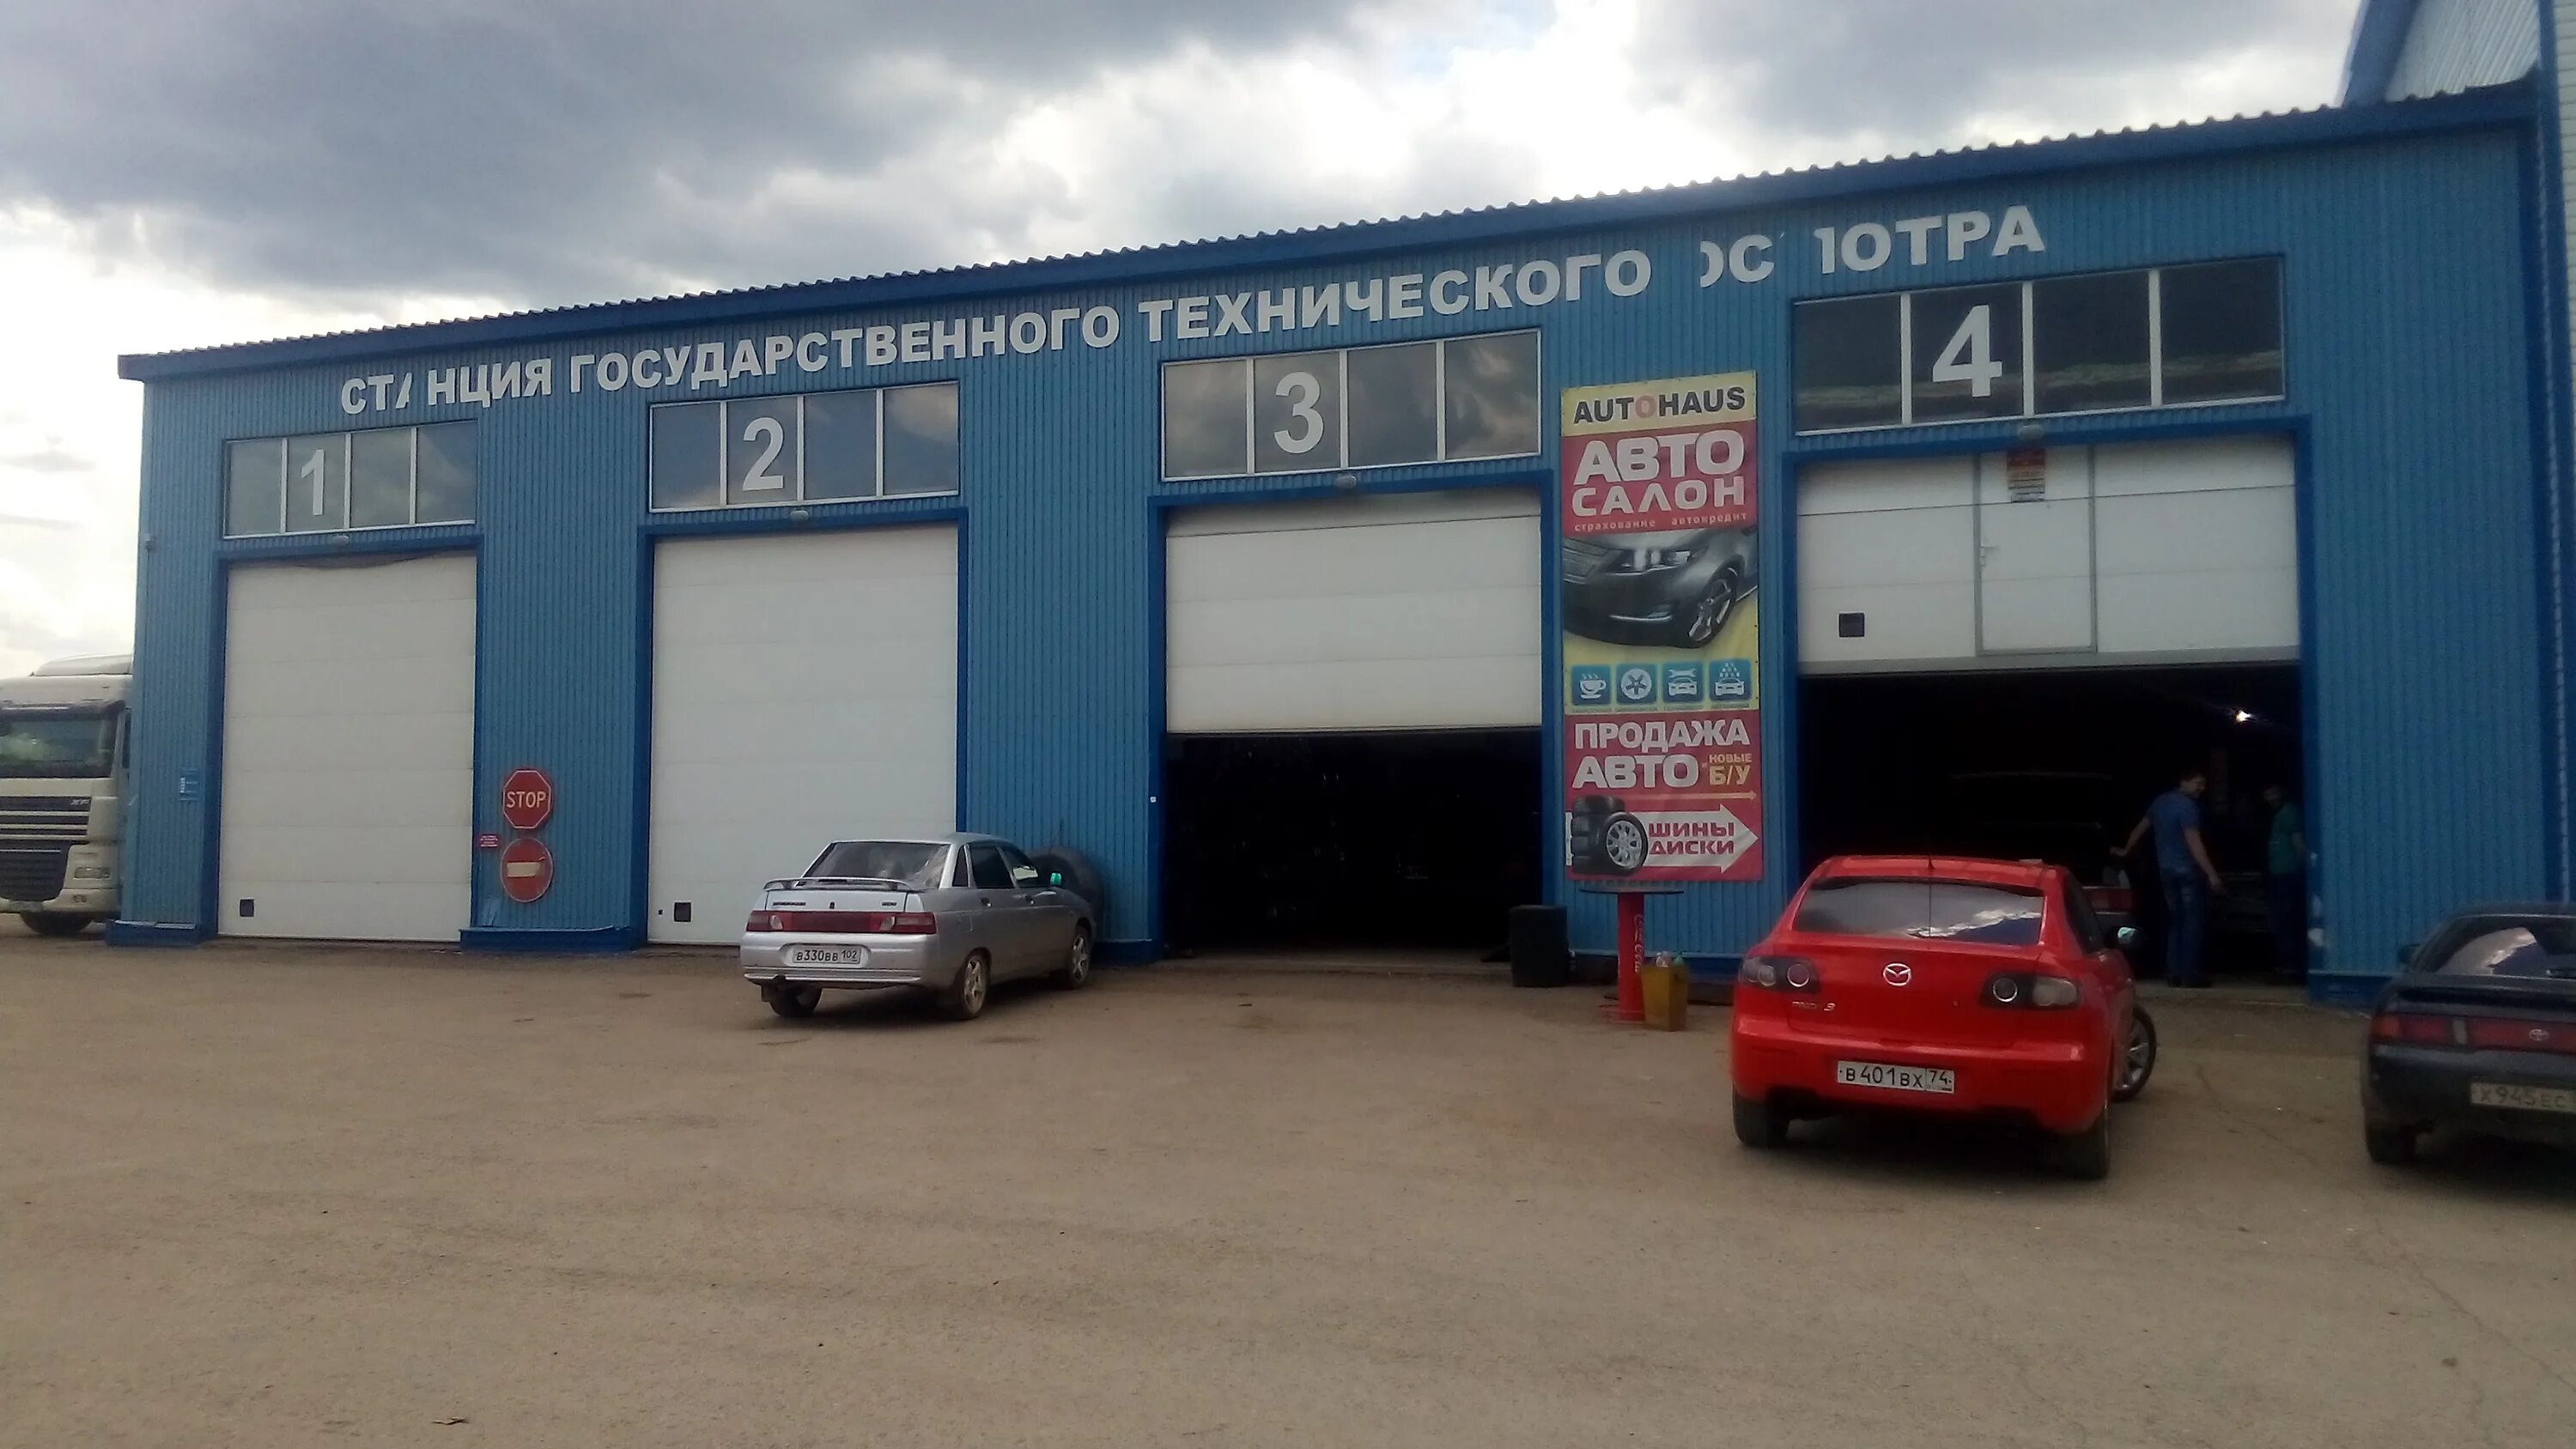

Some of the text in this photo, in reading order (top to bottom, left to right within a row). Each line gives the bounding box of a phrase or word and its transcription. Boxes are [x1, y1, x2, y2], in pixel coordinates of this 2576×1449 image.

[570, 306, 1120, 393] ГОСУДАРСТВЕННОГО
[1138, 250, 1651, 343] ТЕХНИЧЕСКОГО
[1932, 305, 2003, 397] 4
[1273, 371, 1325, 455] 3
[1573, 386, 1746, 424] AUTOHAUS
[742, 417, 786, 492] 2
[1572, 429, 1746, 486] АВТО
[300, 449, 326, 516] 1
[1571, 476, 1746, 517] САЛОН
[1574, 512, 1748, 532] страхование автокредит
[1574, 718, 1751, 753] ПРОДАЖА
[1571, 754, 1699, 789] АВТО
[1709, 753, 1753, 764] НОВЫЕ
[1709, 765, 1752, 786] Б/У
[507, 791, 547, 809] STOP
[1648, 822, 1735, 838] ШИНЫ
[1648, 840, 1735, 856] ДИСКИ
[1845, 1064, 1923, 1088] В401ВХ
